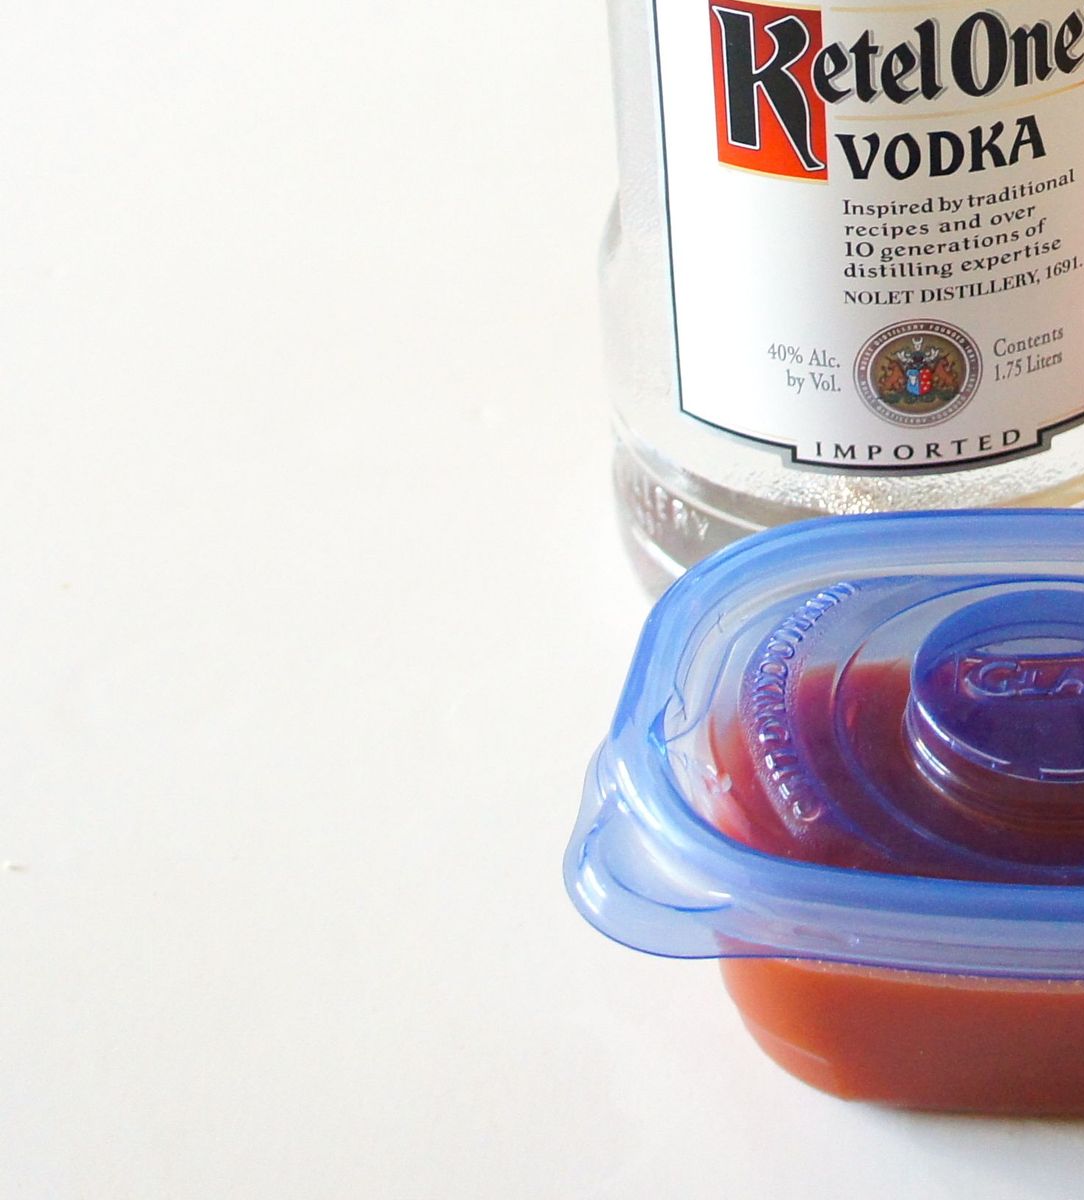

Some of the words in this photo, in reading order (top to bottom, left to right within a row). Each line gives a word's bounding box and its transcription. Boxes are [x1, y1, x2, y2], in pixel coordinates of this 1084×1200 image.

[834, 114, 1047, 181] VODKA
[843, 198, 934, 218] Inspired
[939, 196, 963, 217] by
[968, 168, 1076, 208] traditional
[844, 222, 930, 240] recipes
[939, 213, 982, 233] and
[990, 204, 1036, 226] over
[844, 241, 875, 258] 10
[880, 229, 1020, 262] generations
[1025, 217, 1047, 237] of
[843, 262, 954, 278] distilling
[960, 238, 1062, 272] expertise
[843, 289, 914, 305] NOLET
[921, 269, 1041, 302] DISTILLERY,
[1045, 255, 1083, 280] 1691.
[767, 343, 804, 364] 40%
[809, 350, 841, 368] Alc.
[993, 325, 1064, 358] Contents
[786, 370, 805, 393] by
[809, 373, 842, 392] Vol.
[994, 359, 1022, 382] 1.75
[1026, 351, 1063, 373] Liters
[815, 429, 1021, 461] IMPORTED
